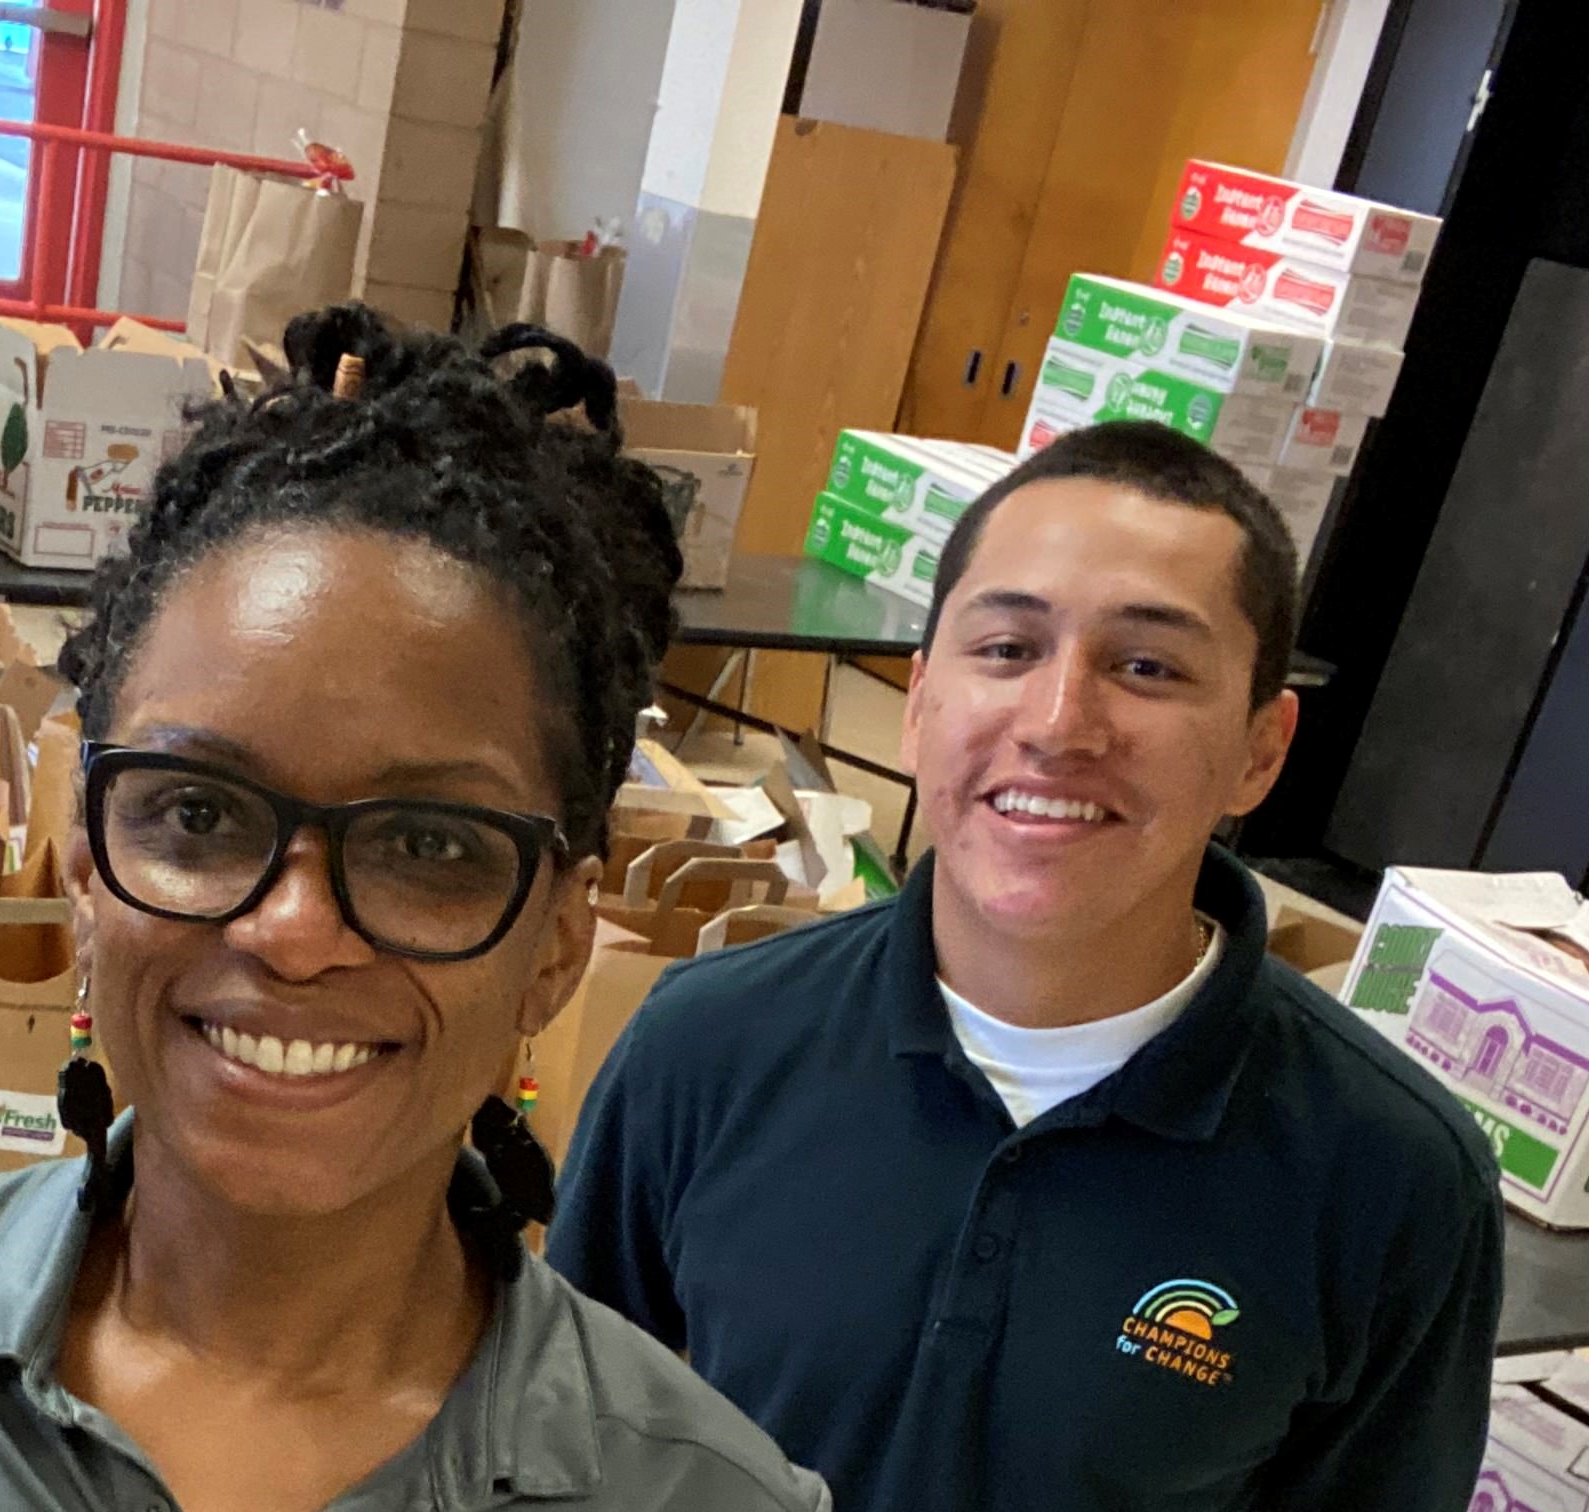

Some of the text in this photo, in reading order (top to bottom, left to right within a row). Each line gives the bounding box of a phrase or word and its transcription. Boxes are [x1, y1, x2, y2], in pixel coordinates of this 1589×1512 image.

[1116, 1334, 1222, 1386] for CHANGE
[1122, 1316, 1231, 1369] CHAMPIONS
